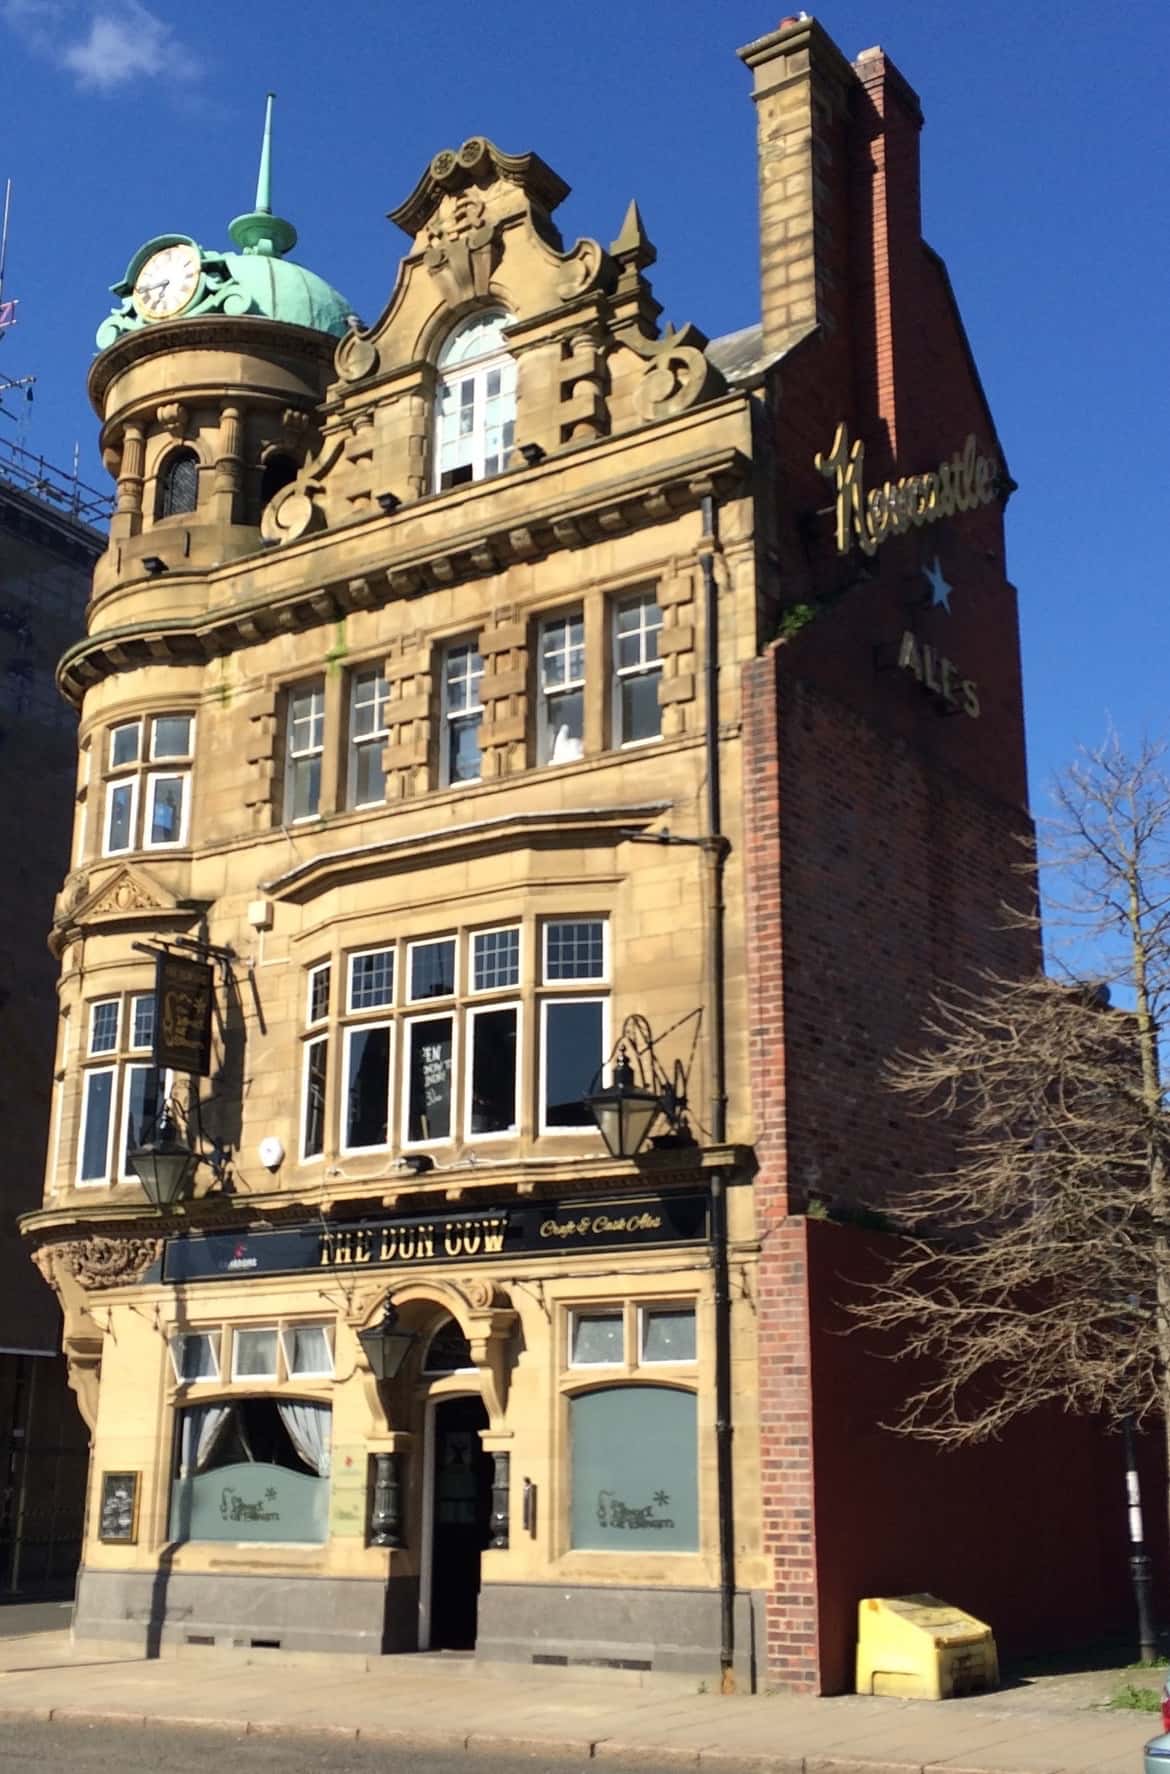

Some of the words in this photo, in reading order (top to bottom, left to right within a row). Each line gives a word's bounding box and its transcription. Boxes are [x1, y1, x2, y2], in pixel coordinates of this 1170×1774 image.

[318, 1230, 373, 1265] THE
[380, 1226, 434, 1260] DUN
[444, 1219, 508, 1256] COW
